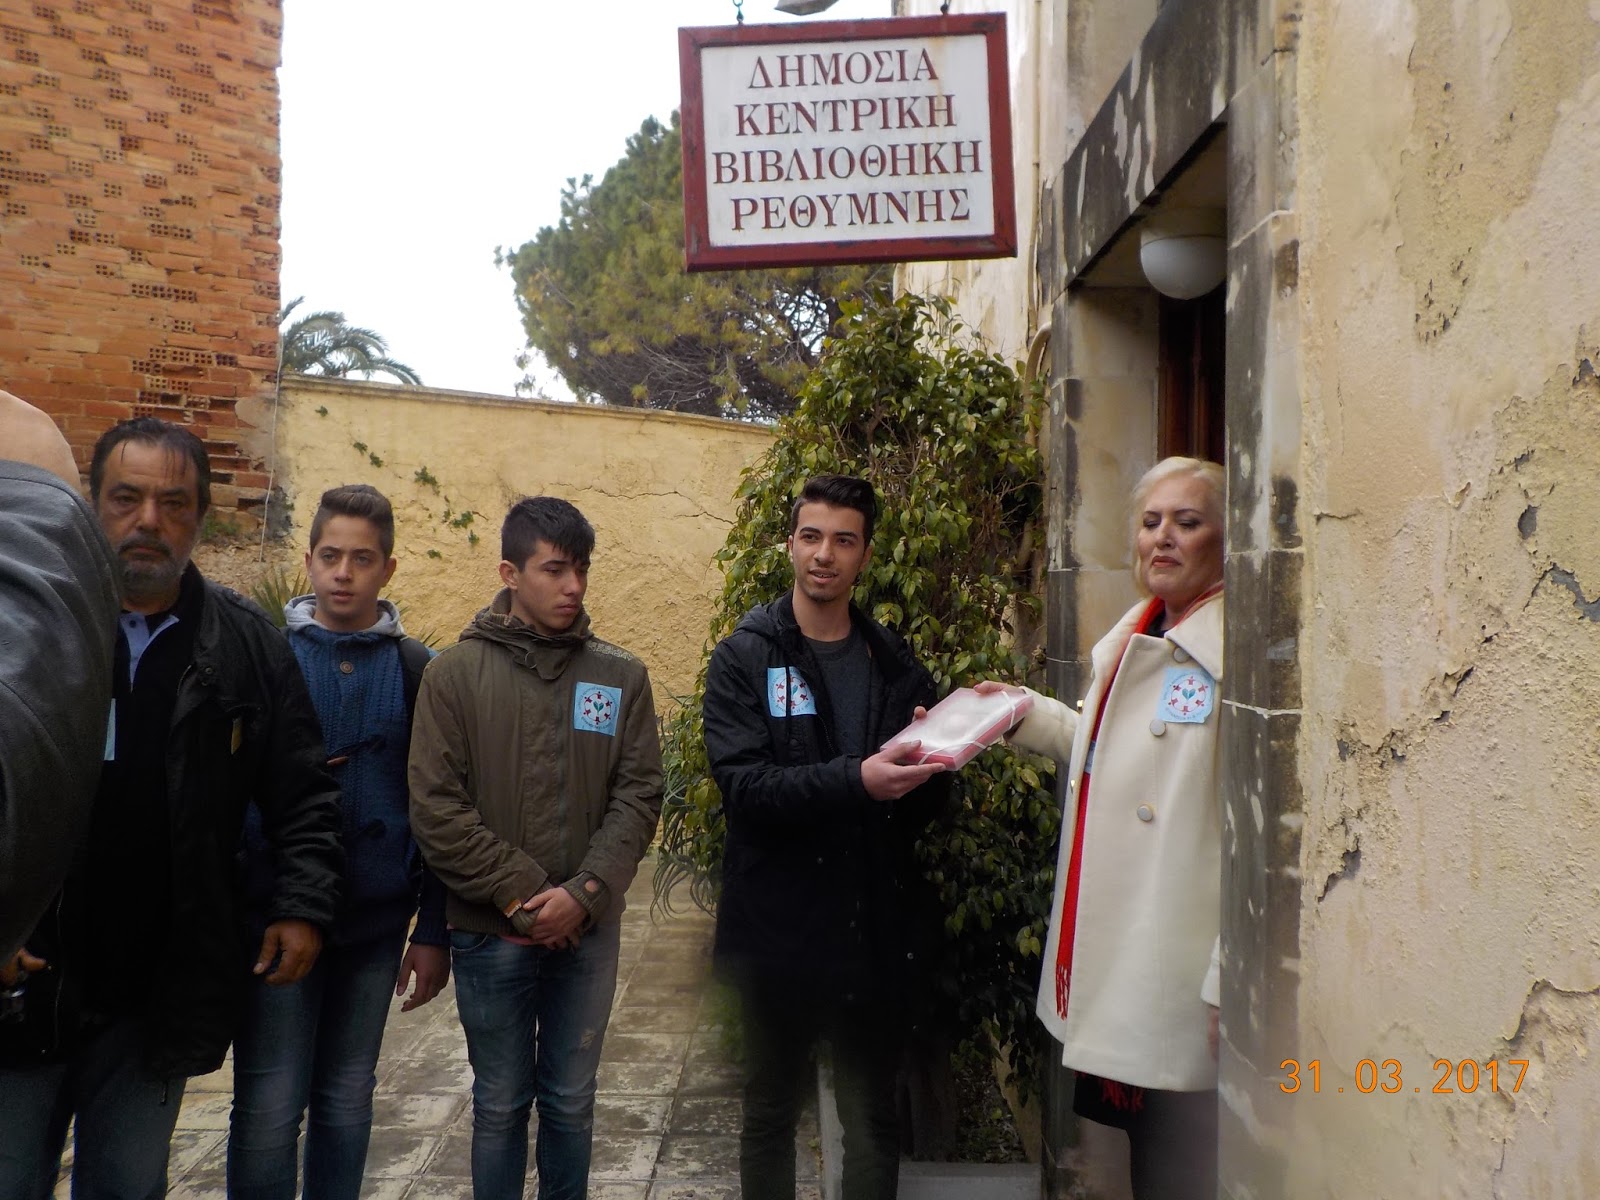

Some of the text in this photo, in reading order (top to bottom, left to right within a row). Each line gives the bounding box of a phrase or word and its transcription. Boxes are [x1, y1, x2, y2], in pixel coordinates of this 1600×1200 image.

[748, 48, 938, 89] ΔΗΜΟΣΙΑ
[735, 94, 957, 137] ΚΕΝΤΡΙΚΗ
[712, 140, 983, 184] ΒΙΒΛΙΟΘΗΚΗ
[731, 188, 970, 231] ΡΕΘΥΜΝΗΣ
